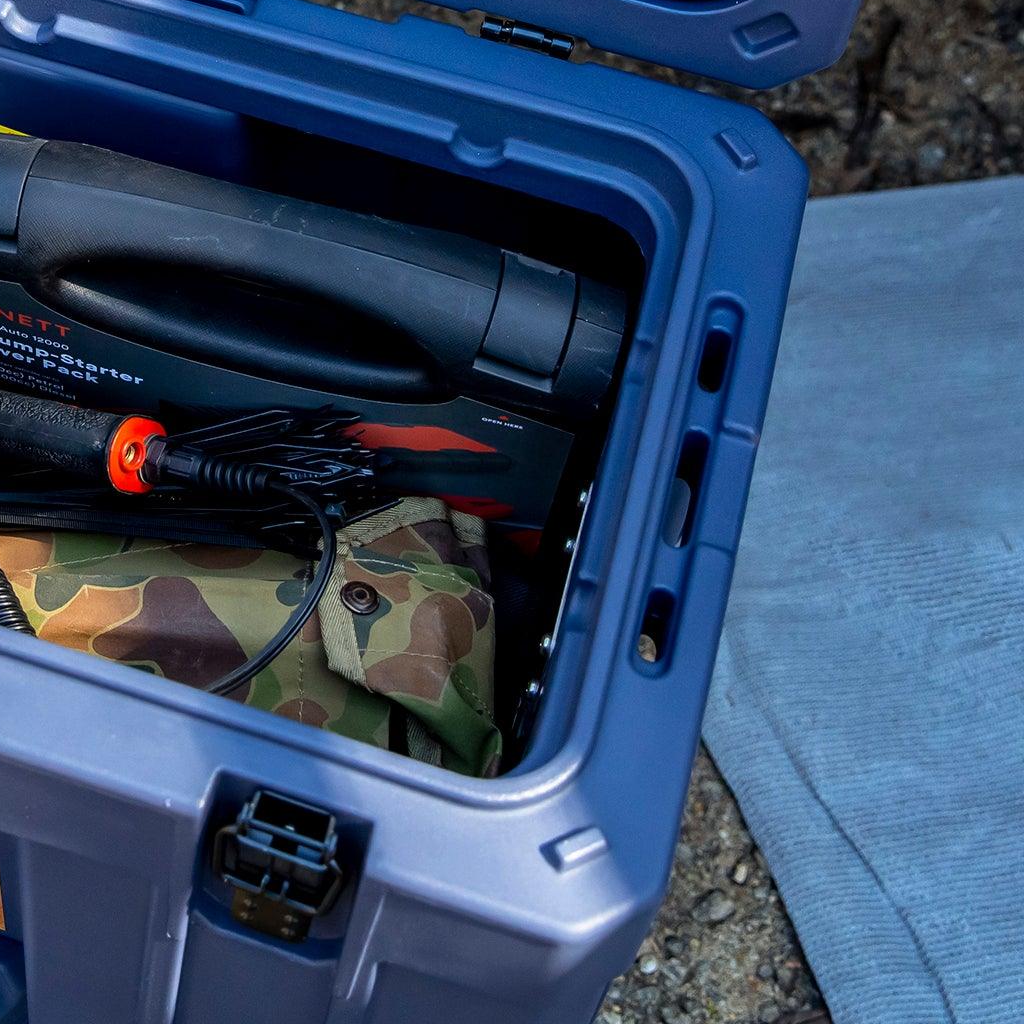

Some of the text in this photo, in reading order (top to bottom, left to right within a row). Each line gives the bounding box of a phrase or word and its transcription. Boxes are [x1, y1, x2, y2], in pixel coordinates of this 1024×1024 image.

[0, 324, 29, 339] Auto
[31, 335, 70, 351] 12000
[28, 374, 65, 391] Petrol
[42, 359, 99, 385] Pack
[481, 417, 523, 430] OPEN HERE
